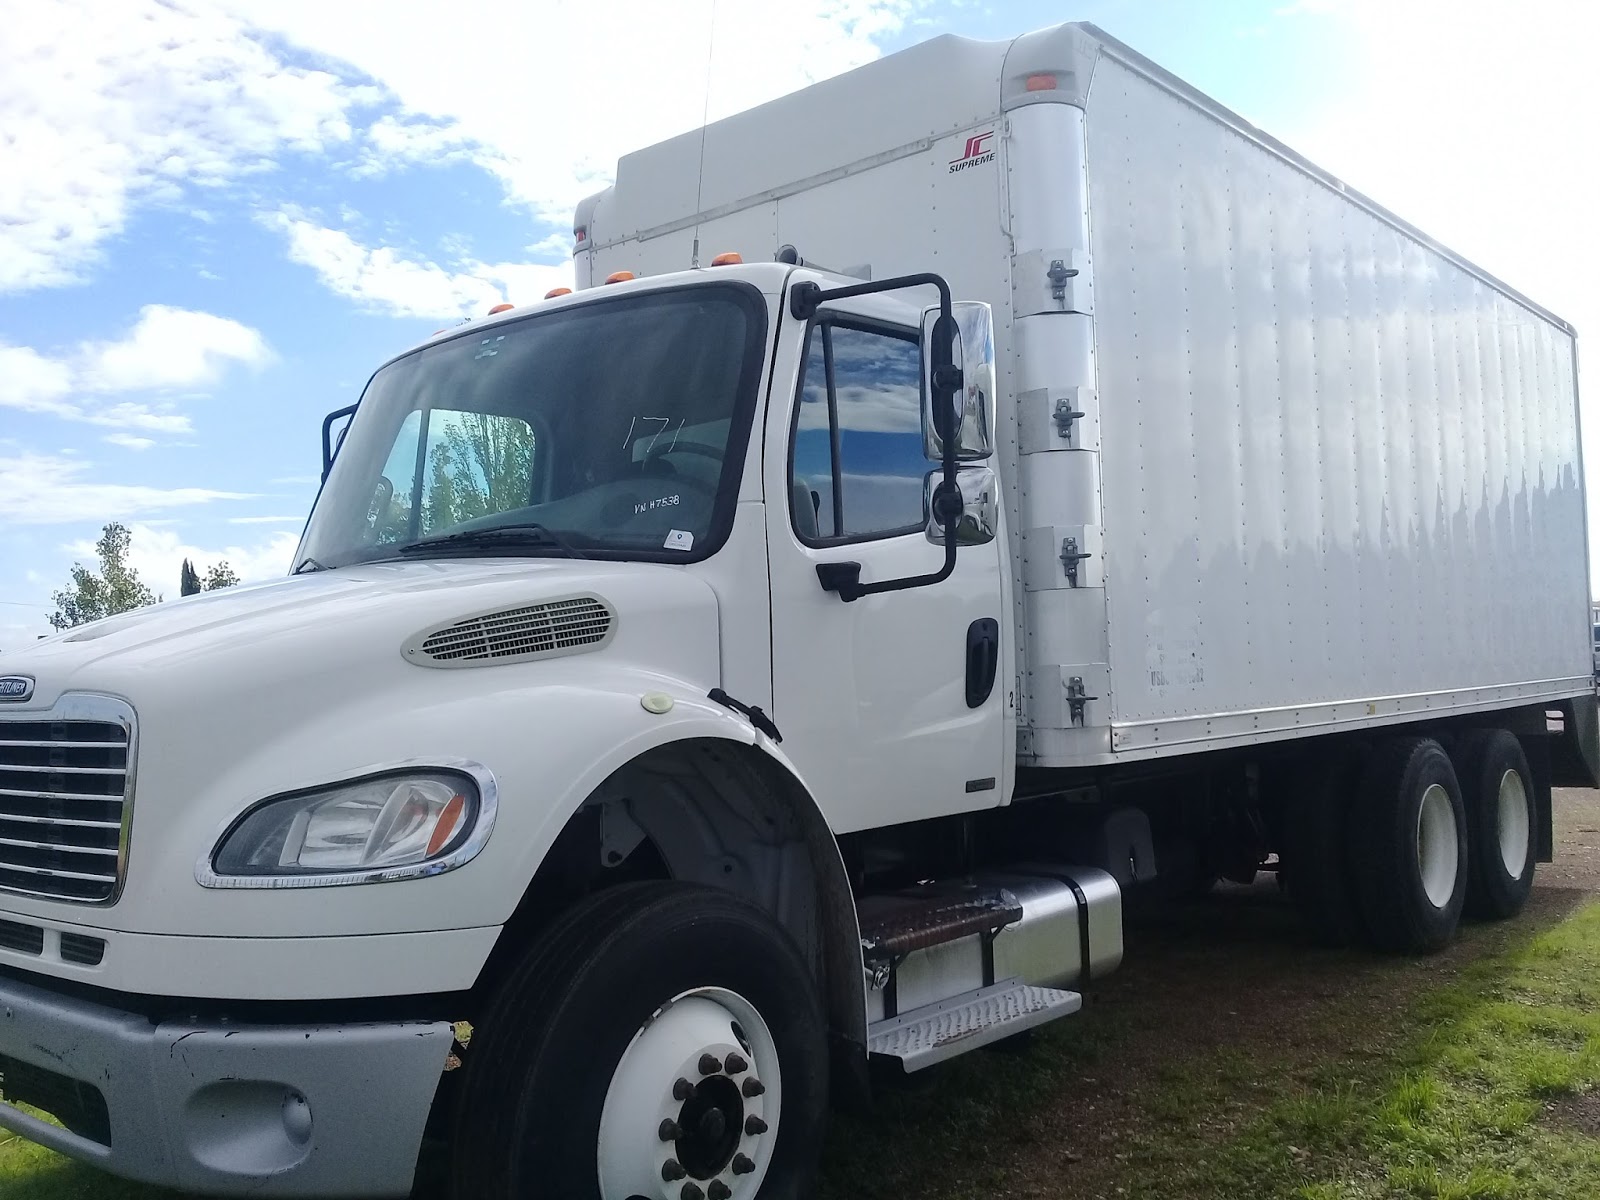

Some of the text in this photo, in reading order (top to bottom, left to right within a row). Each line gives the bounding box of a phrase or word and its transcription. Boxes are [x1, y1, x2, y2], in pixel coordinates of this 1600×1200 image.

[949, 152, 996, 174] SUPREME
[622, 416, 686, 453] 171
[0, 681, 26, 693] HTLINER
